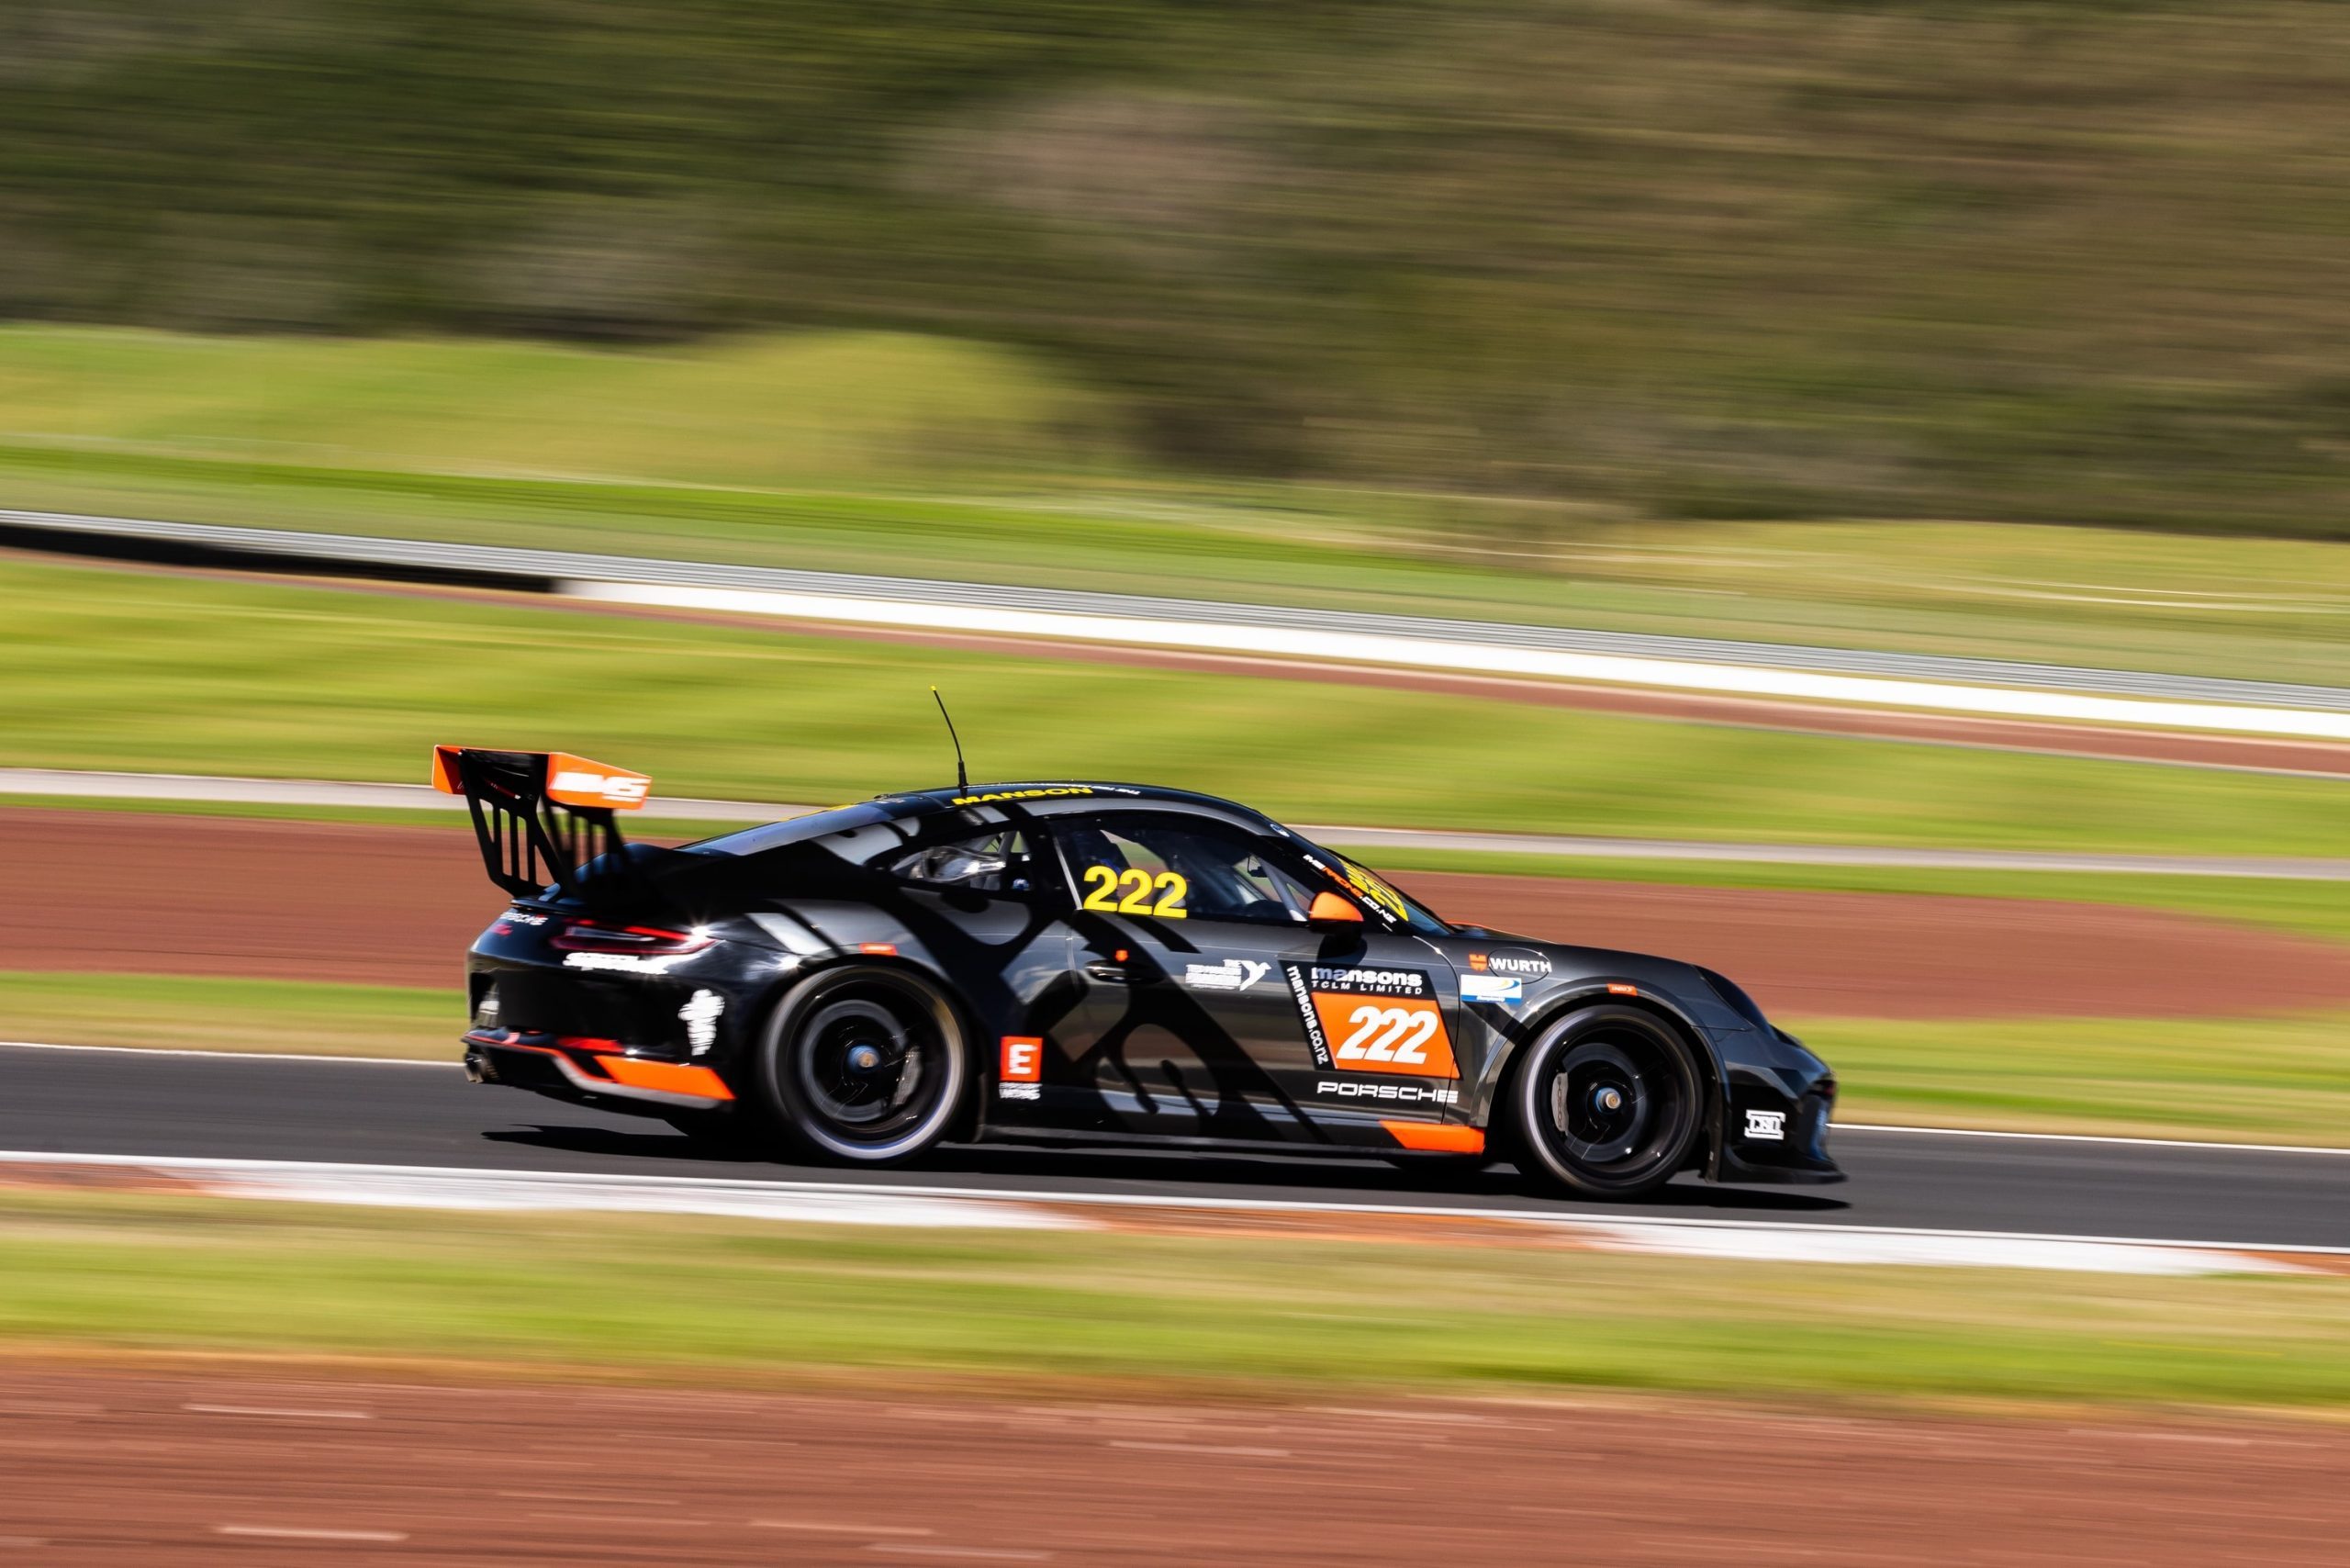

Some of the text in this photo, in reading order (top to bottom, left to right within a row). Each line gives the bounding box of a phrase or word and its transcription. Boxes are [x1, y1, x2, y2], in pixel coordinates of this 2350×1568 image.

[952, 788, 1094, 806] MANSON
[1083, 866, 1187, 918] 222
[1489, 958, 1552, 973] WURTH
[1311, 967, 1423, 987] mansons
[1311, 980, 1423, 995] TCLM LIMITED
[1287, 966, 1328, 1065] mansons.co.nz
[1336, 1005, 1438, 1065] 222
[1316, 1081, 1459, 1104] PORSCHE
